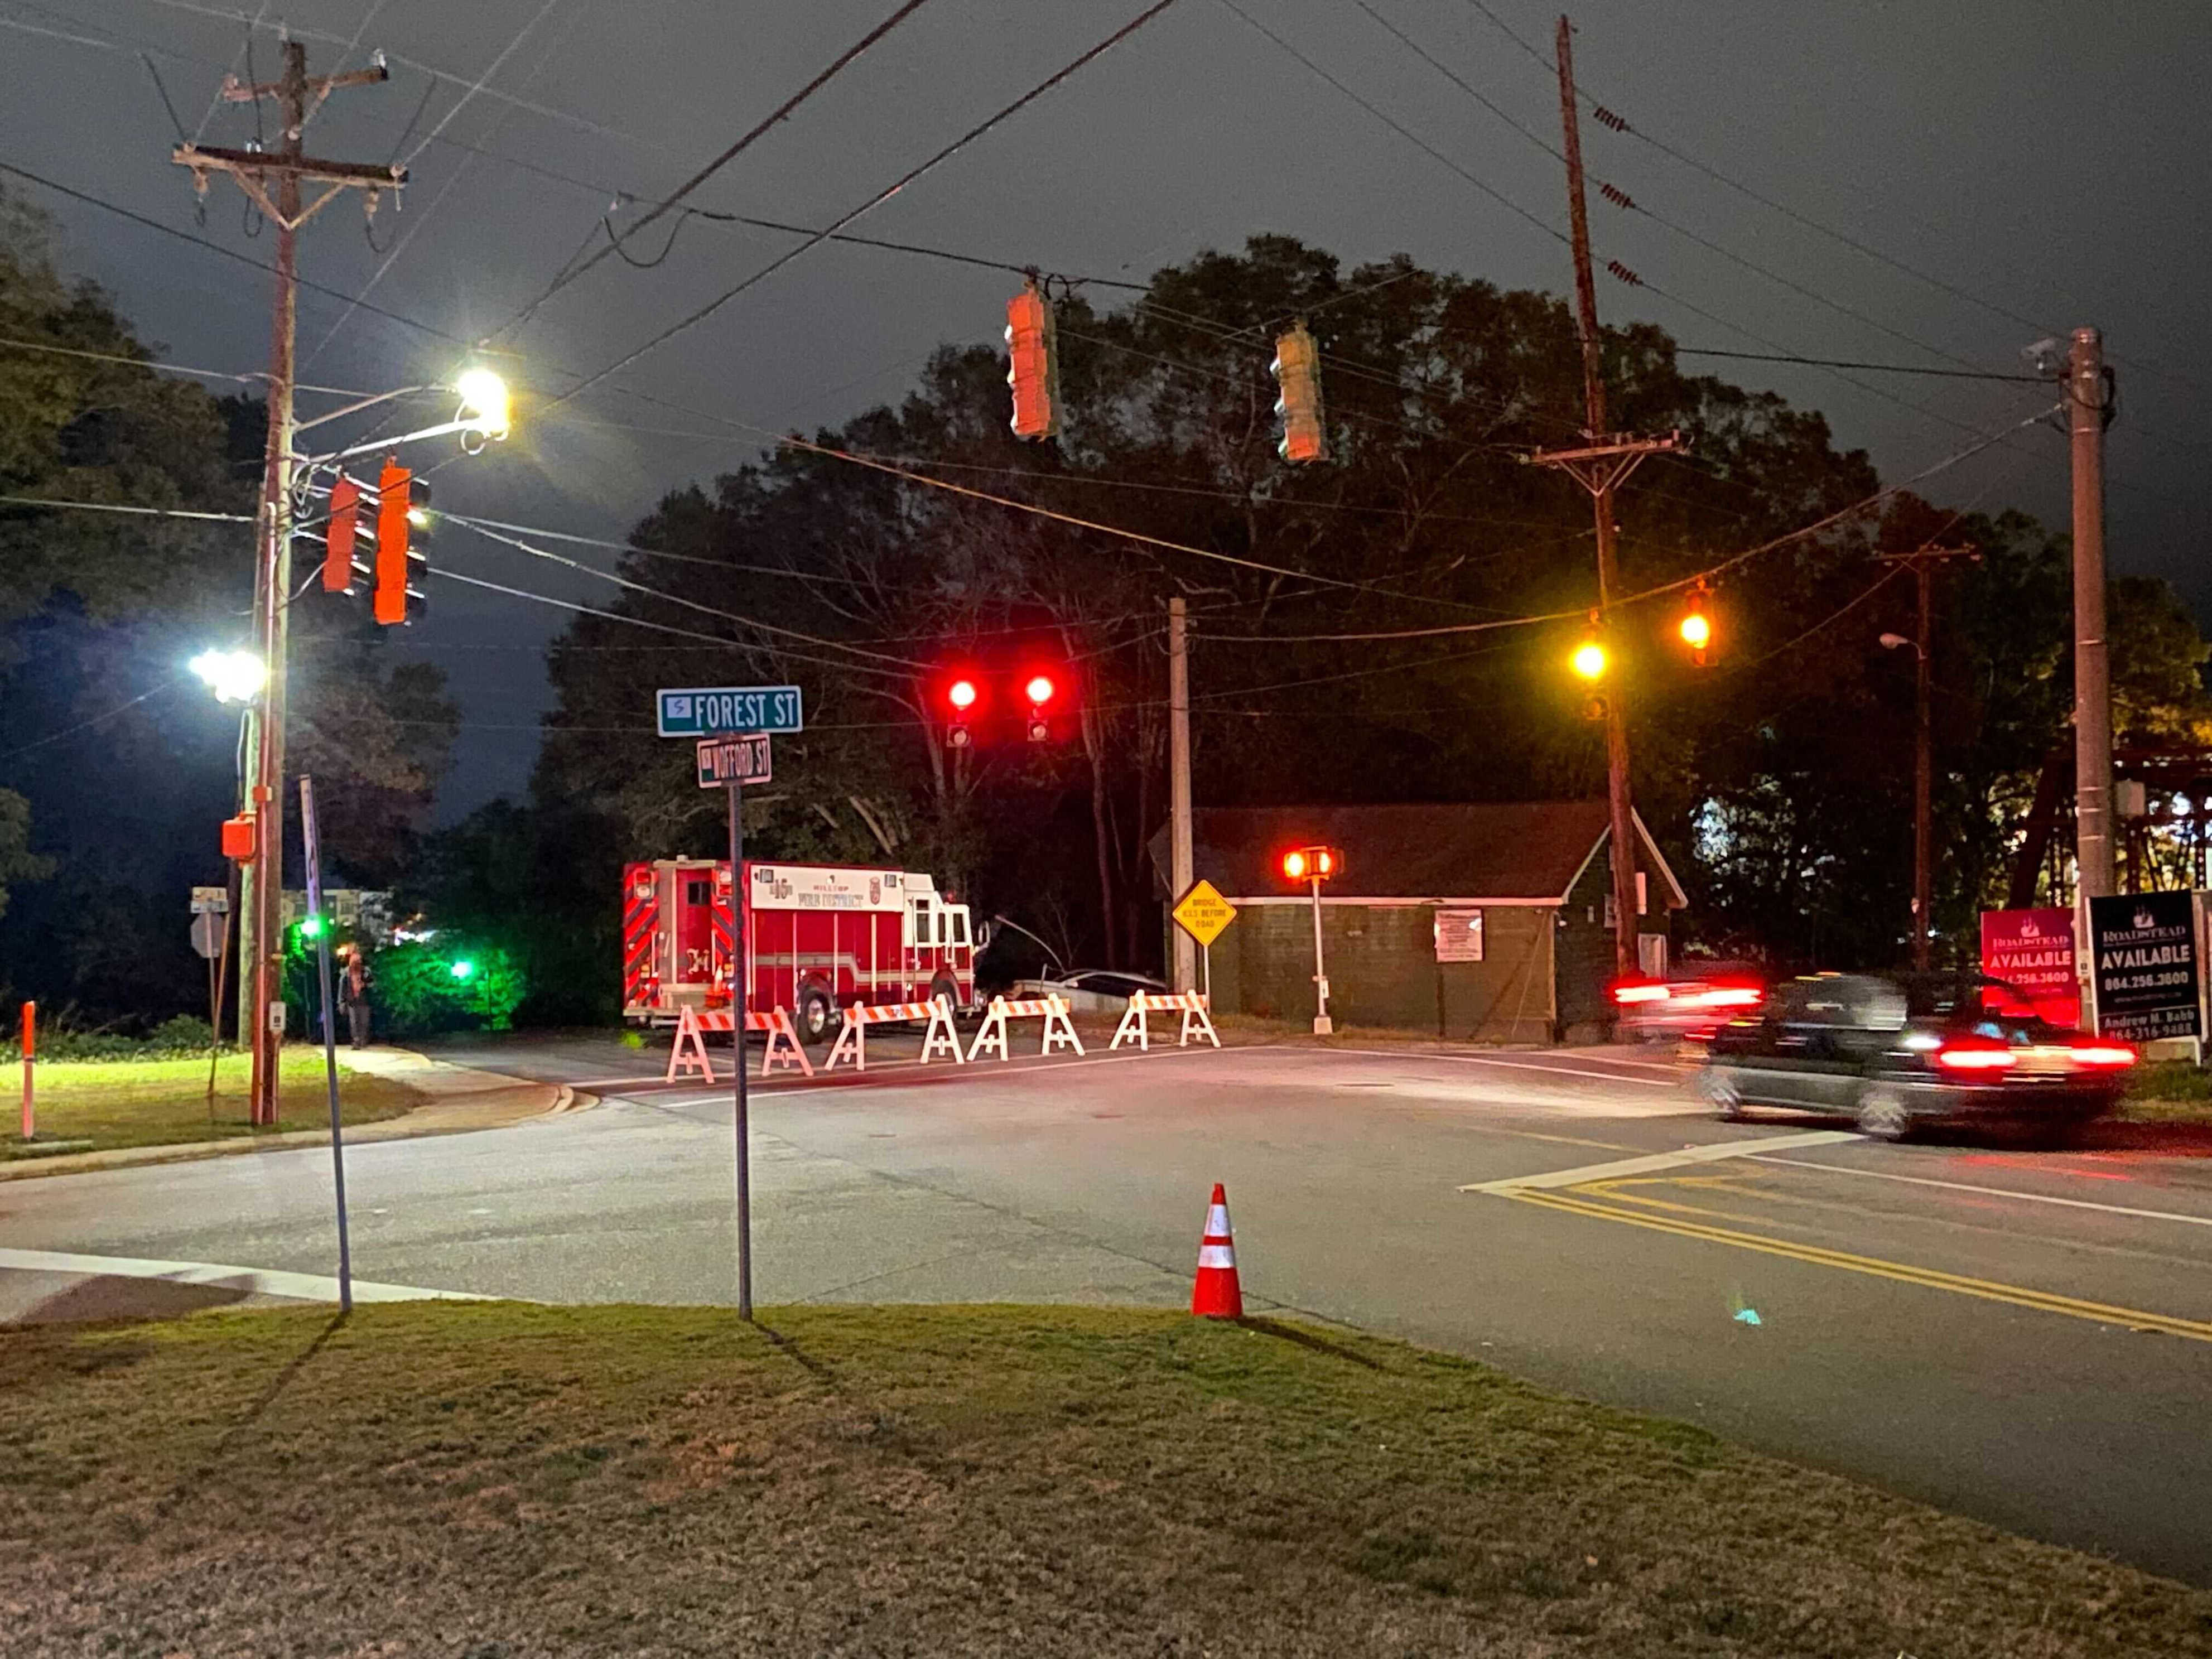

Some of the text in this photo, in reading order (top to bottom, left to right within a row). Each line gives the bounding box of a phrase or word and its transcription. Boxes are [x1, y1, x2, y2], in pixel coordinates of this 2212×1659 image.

[695, 694, 766, 727] FOREST
[774, 693, 795, 725] ST
[755, 741, 767, 774] ST
[2103, 925, 2186, 942] ROADSTEAD
[1989, 950, 2071, 968] AVAILABLE
[2101, 944, 2191, 970] AVAILABLE
[2105, 1015, 2147, 1029] Andrew
